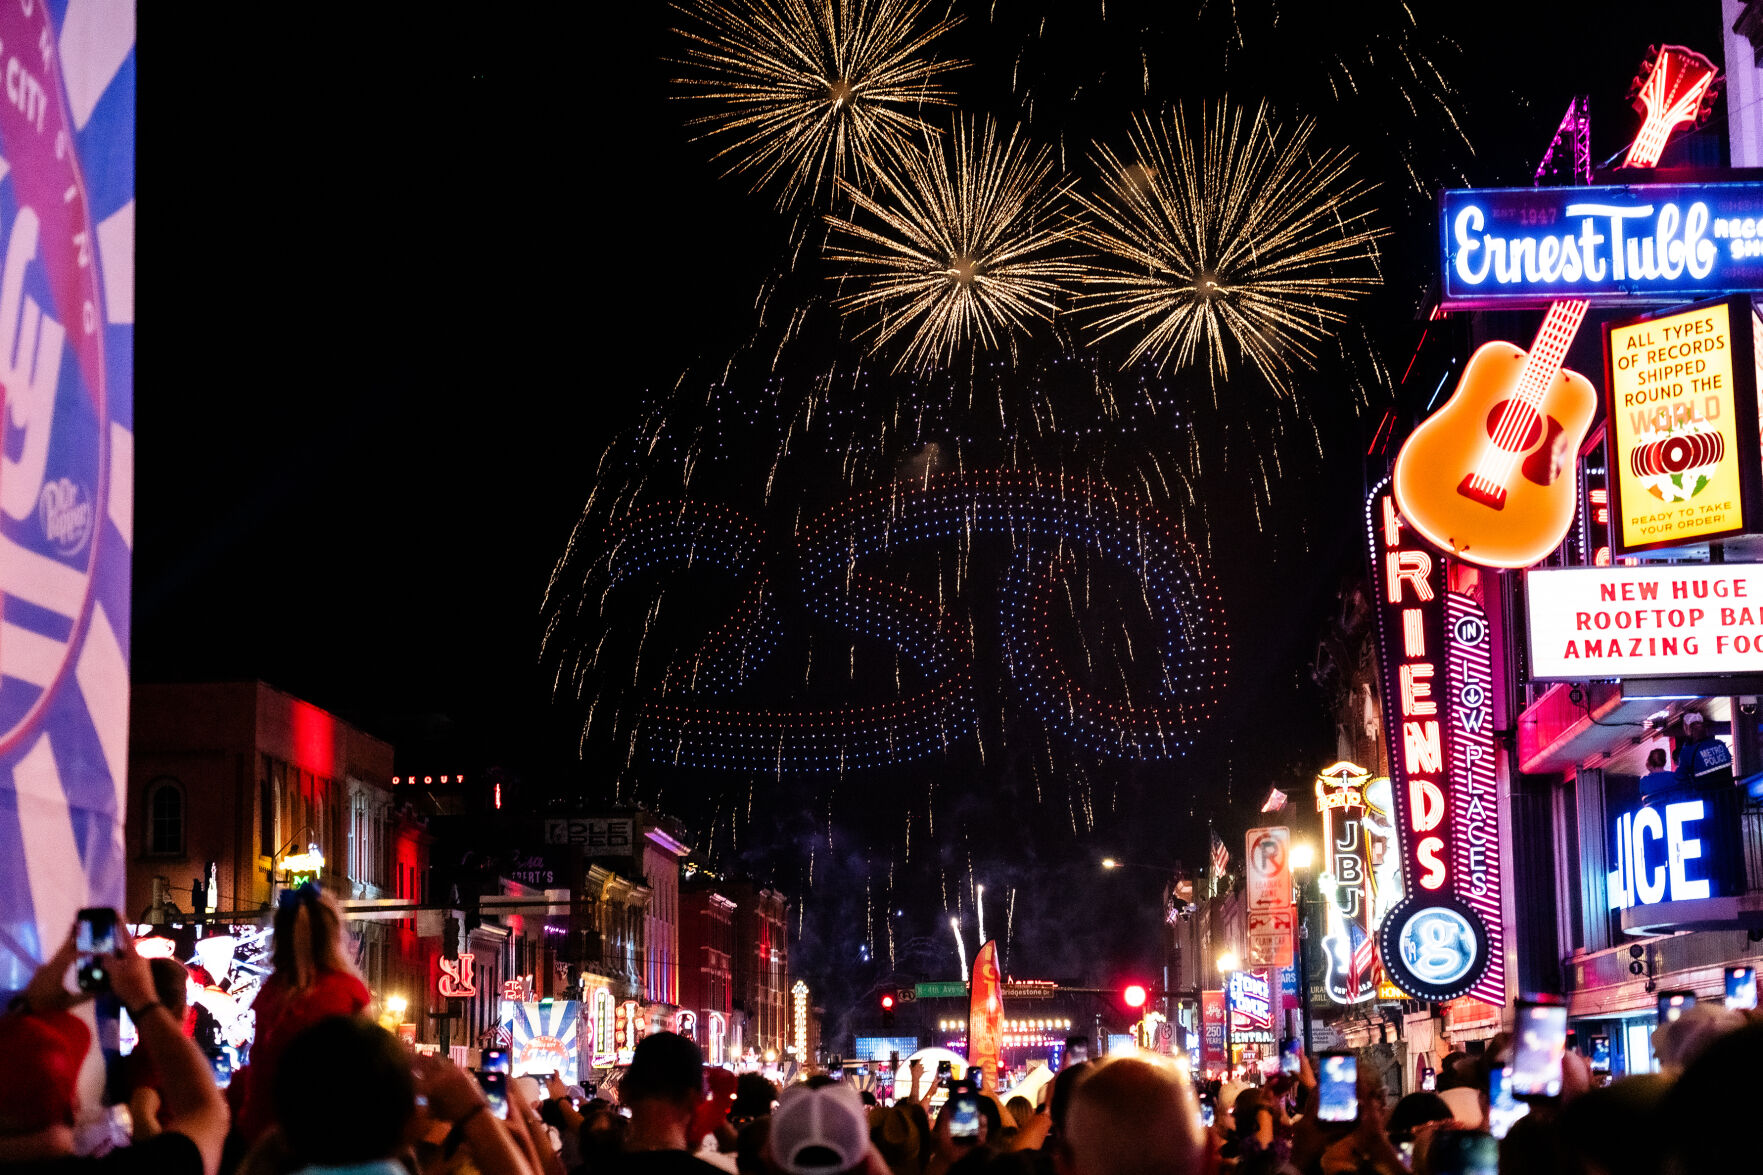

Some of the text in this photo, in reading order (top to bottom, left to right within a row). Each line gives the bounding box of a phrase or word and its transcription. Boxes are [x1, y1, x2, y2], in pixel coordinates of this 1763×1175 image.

[1520, 207, 1557, 224] 1947
[1454, 201, 1718, 285] Ernest Tubb
[1731, 240, 1763, 259] SH
[1627, 318, 1714, 350] ALL TYPES
[1618, 335, 1725, 371] OF RECORDS
[1638, 359, 1706, 386] SHIPPED
[1625, 374, 1722, 407] ROUND THE
[1629, 395, 1721, 435] WORLD
[1631, 501, 1732, 526] READY TO TAKE
[1640, 515, 1726, 535] YOUR ORDER!
[1600, 578, 1748, 602] NEW HUGE
[1462, 622, 1477, 639] IN
[1576, 606, 1763, 631] ROOFTOP BA
[1563, 636, 1699, 659] AMAZING
[1699, 744, 1724, 758] METRO
[1703, 755, 1727, 767] POLICE
[1465, 745, 1488, 897] PLACES
[1206, 1026, 1222, 1037] 250
[1206, 1037, 1222, 1045] YEARS
